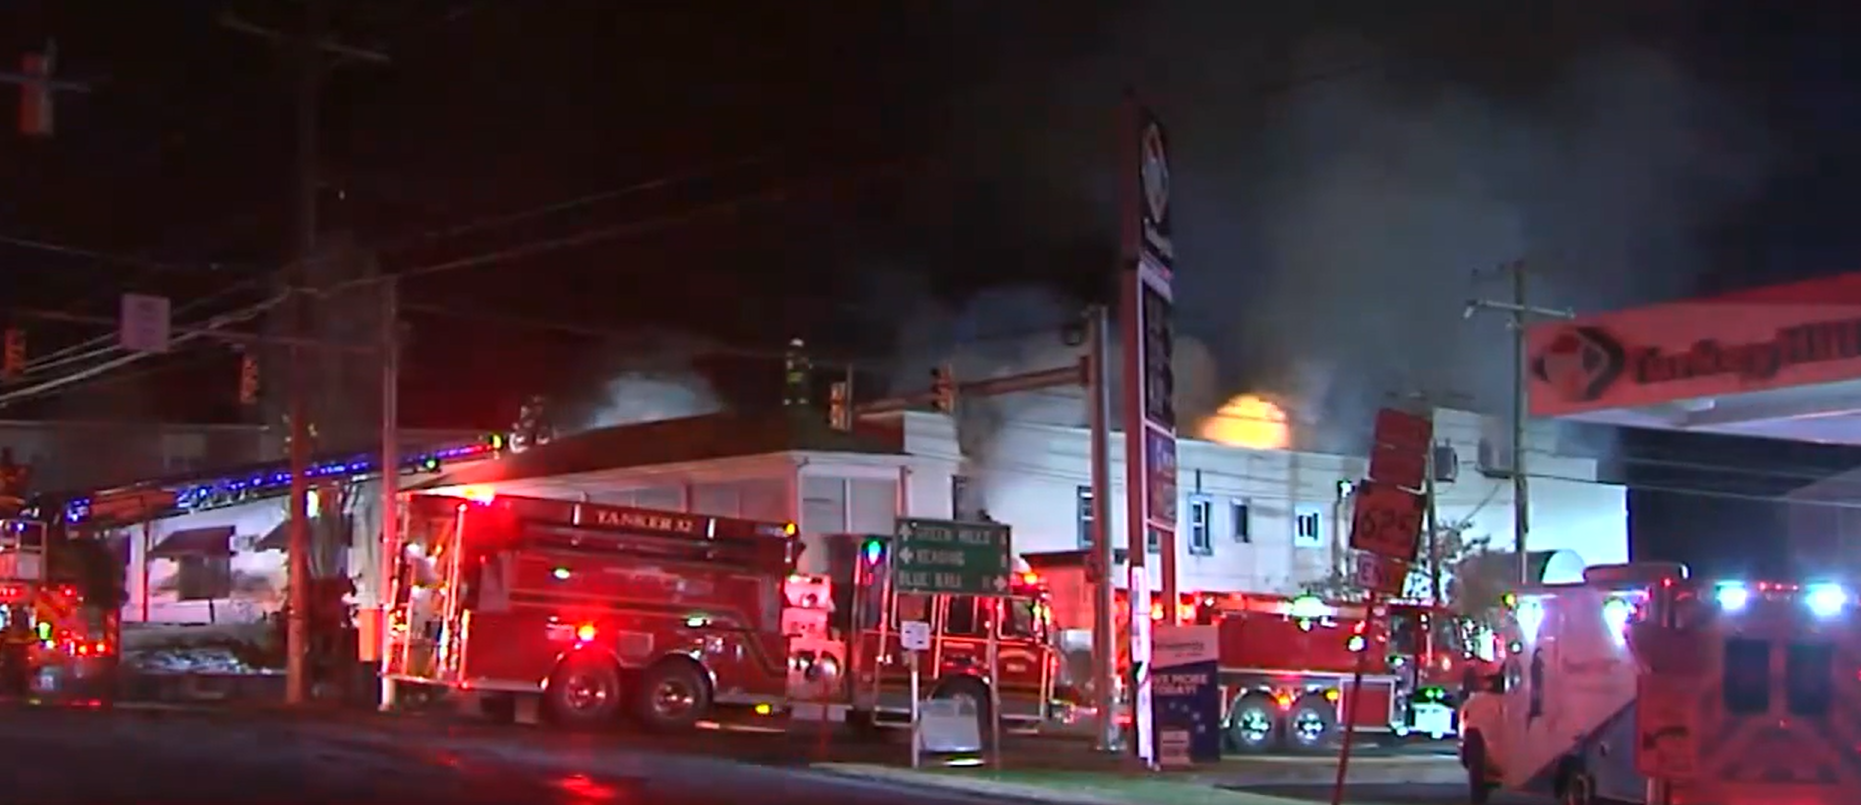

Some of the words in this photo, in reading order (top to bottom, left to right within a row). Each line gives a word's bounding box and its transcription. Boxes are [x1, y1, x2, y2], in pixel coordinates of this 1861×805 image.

[597, 509, 672, 531] TANKER
[674, 519, 694, 533] 32
[1361, 509, 1416, 548] 625
[917, 549, 966, 567] READING
[898, 571, 930, 587] BLUE
[1171, 673, 1209, 685] MORE
